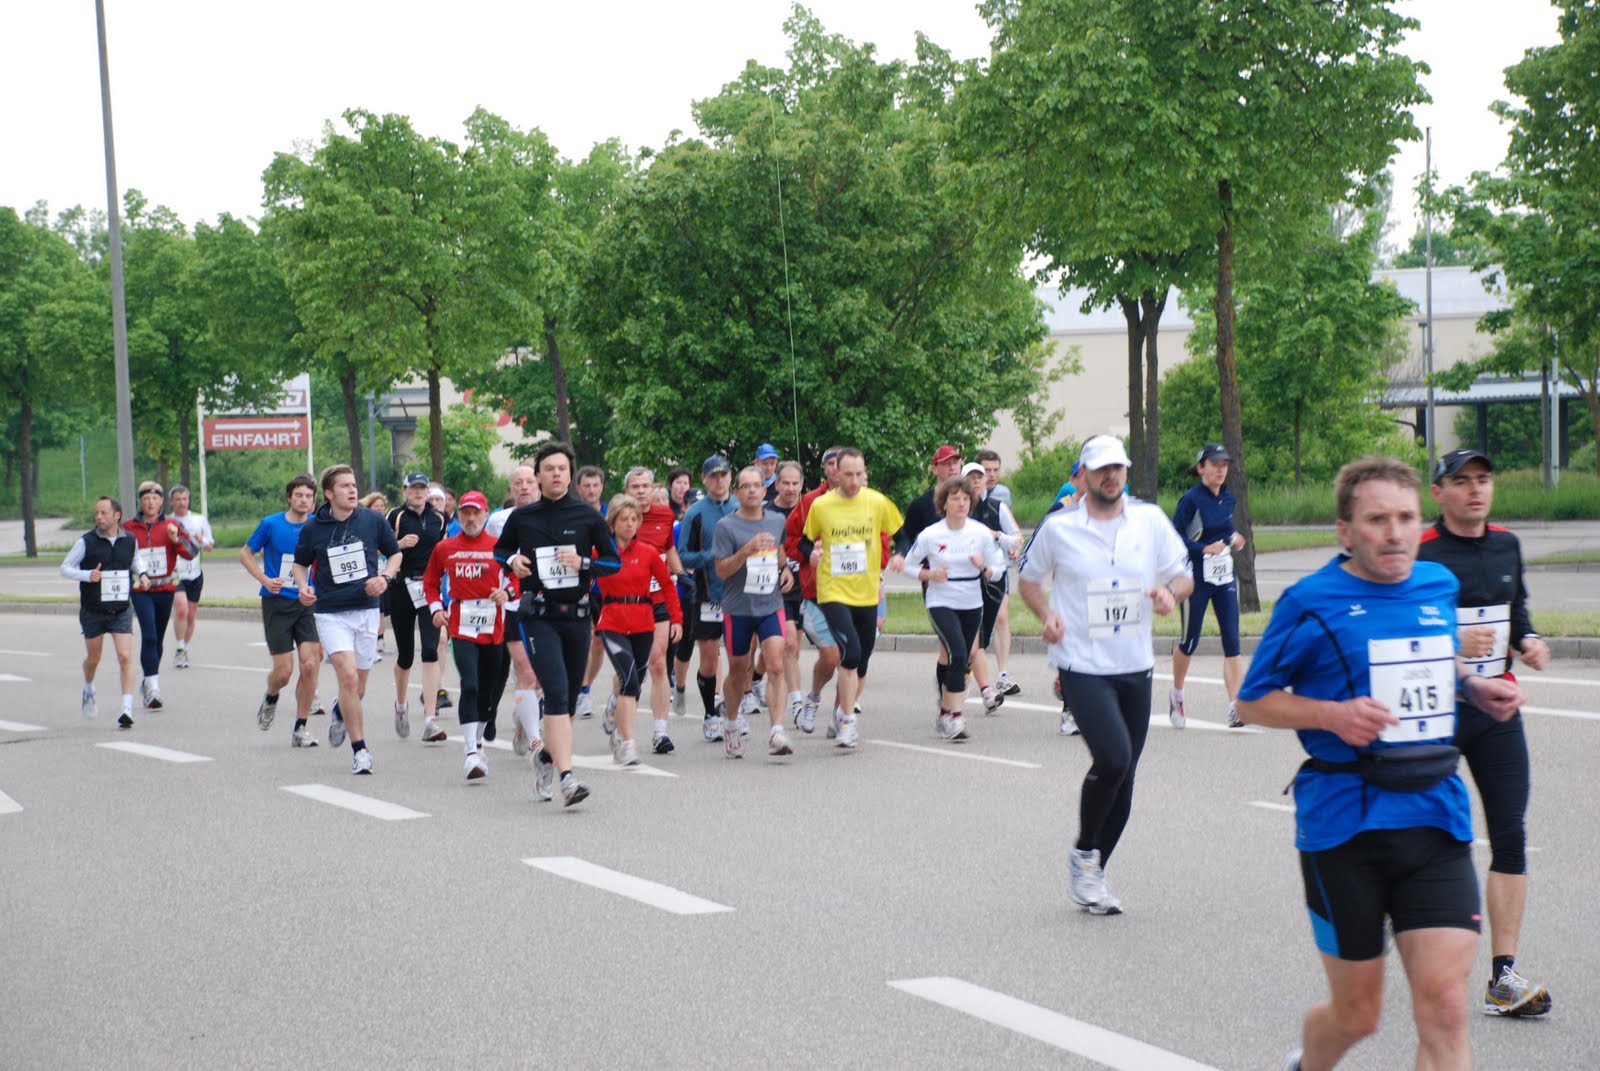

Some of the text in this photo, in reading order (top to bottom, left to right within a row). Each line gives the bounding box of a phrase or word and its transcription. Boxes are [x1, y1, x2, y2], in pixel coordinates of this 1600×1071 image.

[211, 432, 302, 447] EINFAHRT
[340, 560, 358, 573] 993
[470, 615, 487, 625] 276
[1104, 605, 1128, 621] 197
[1400, 684, 1439, 712] 415
